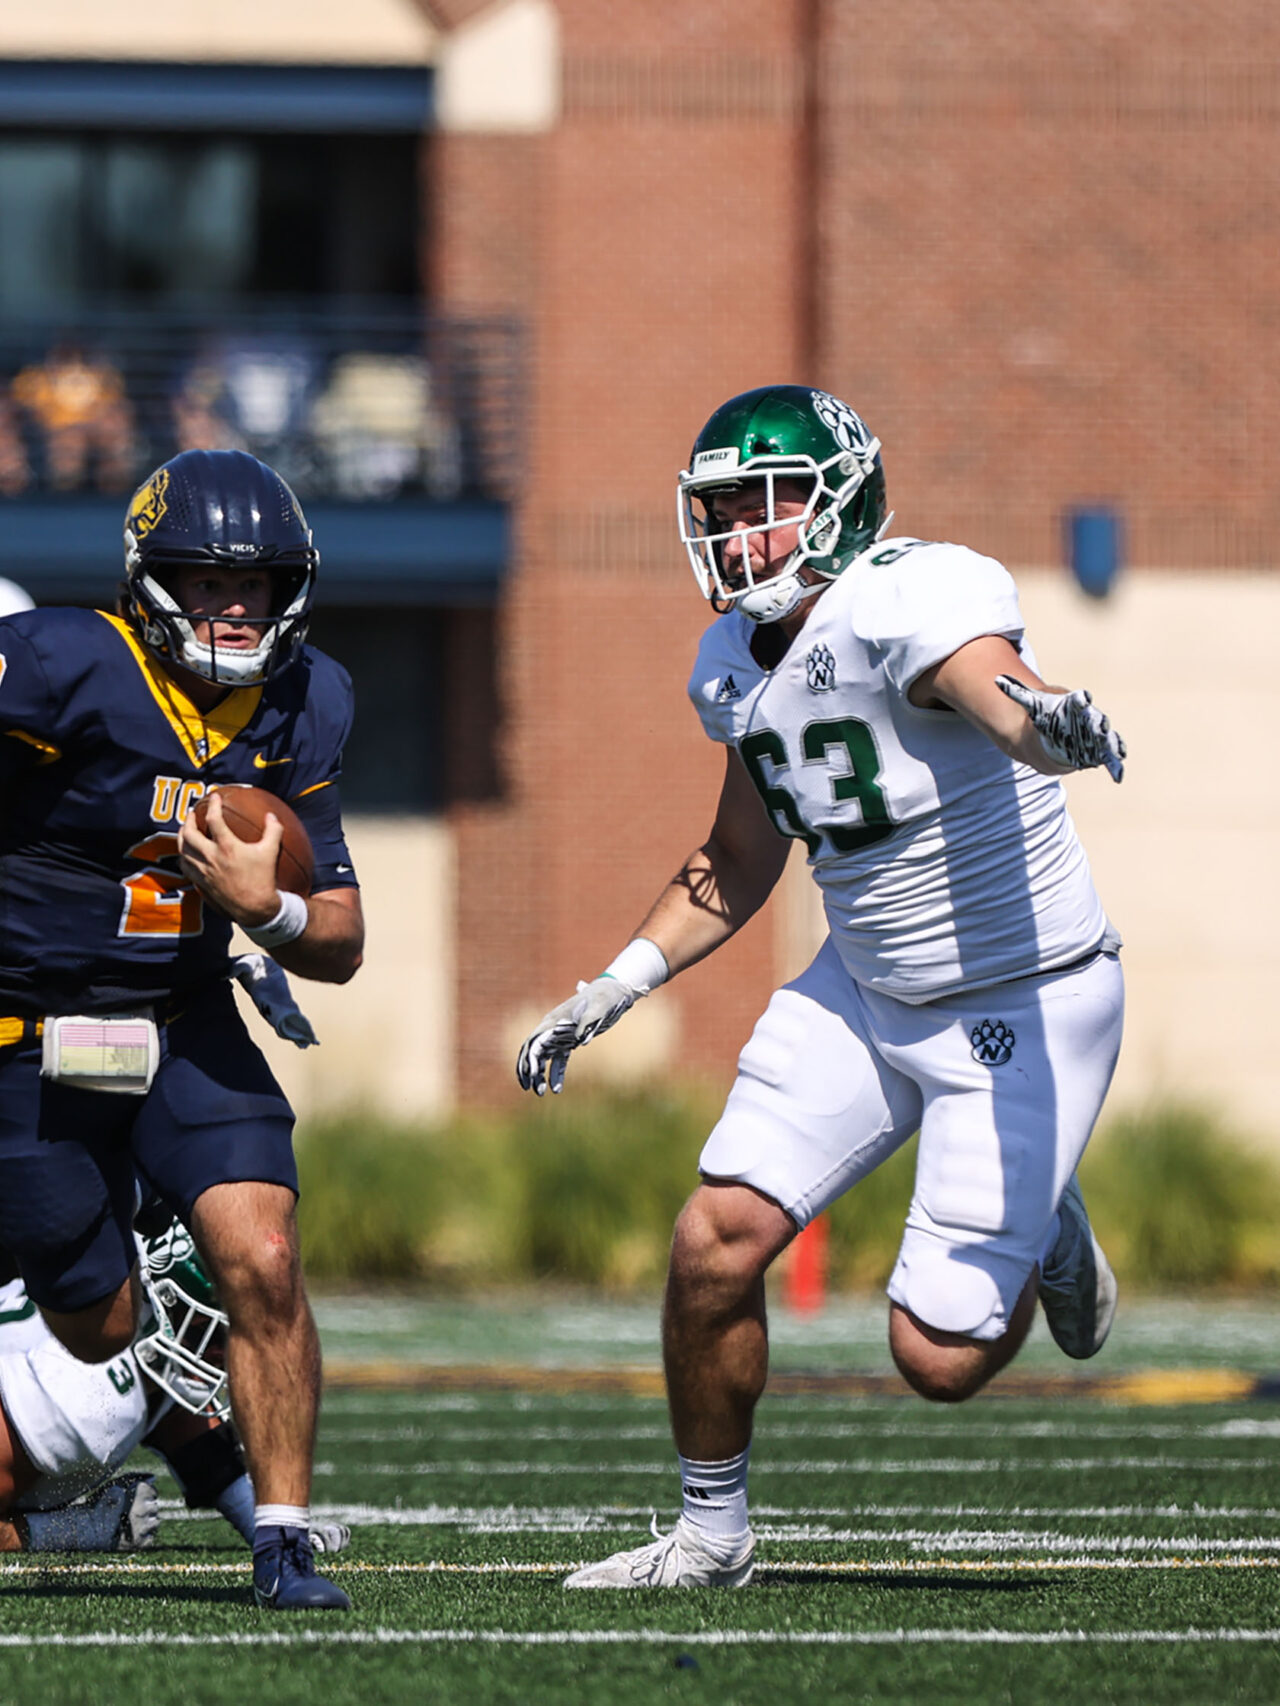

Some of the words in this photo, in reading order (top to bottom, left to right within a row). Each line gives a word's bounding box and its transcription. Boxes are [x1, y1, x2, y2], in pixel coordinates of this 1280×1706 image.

[699, 451, 730, 465] FAMILY
[230, 543, 256, 553] VICIS
[150, 775, 254, 825] UC
[737, 715, 900, 863] 63
[118, 831, 205, 938] 2
[107, 1356, 136, 1397] 3
